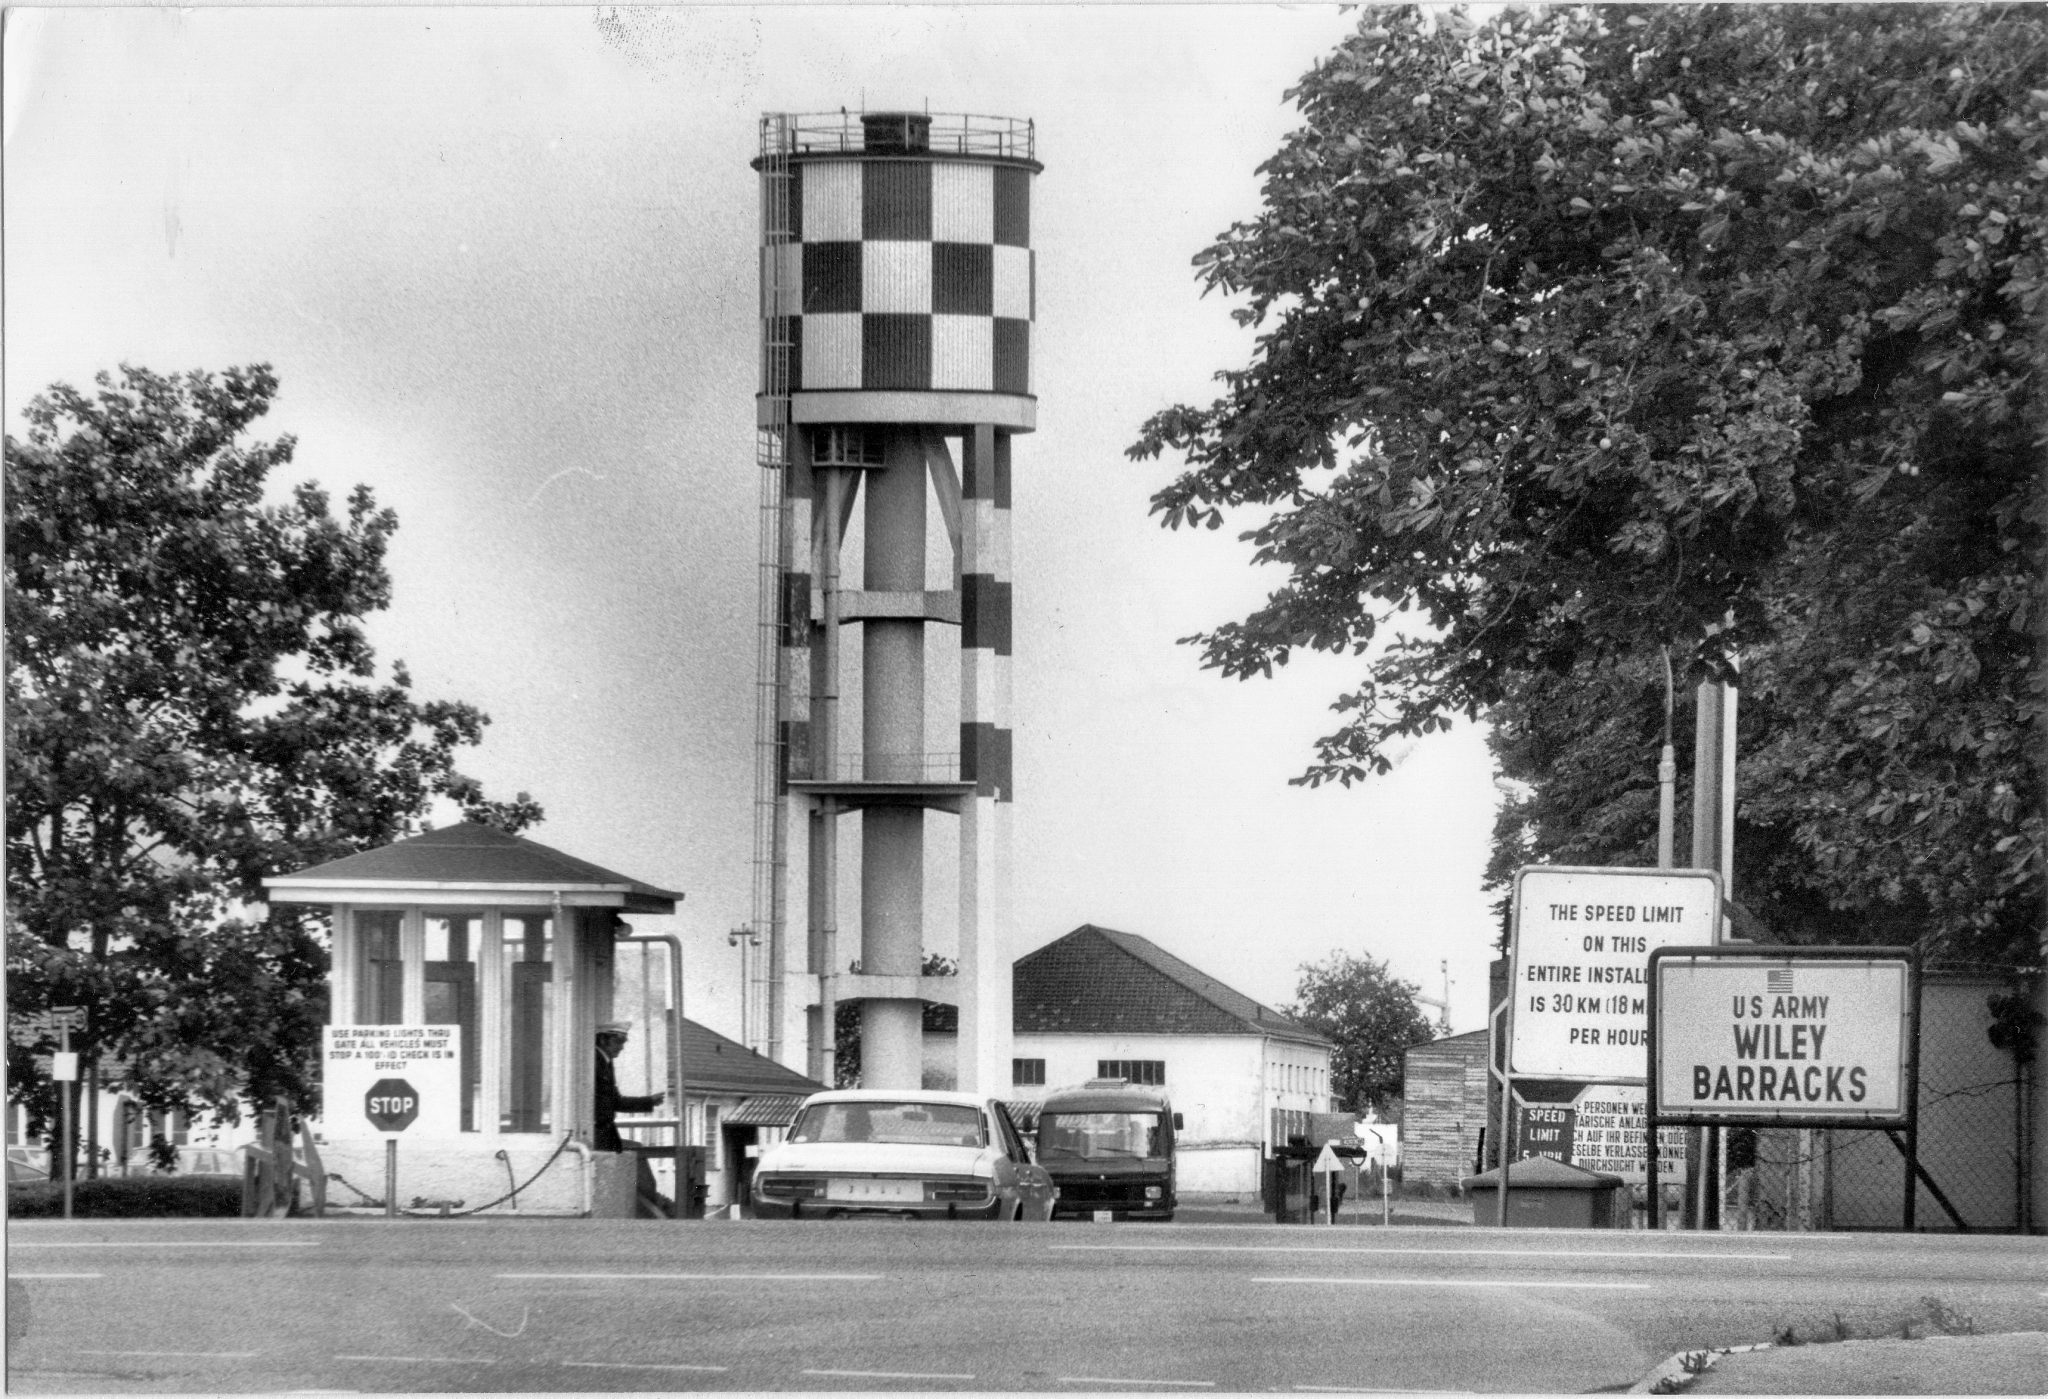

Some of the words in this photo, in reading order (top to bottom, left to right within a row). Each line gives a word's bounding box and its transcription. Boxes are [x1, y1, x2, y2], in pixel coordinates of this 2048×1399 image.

[1549, 904, 1578, 921] THE
[1585, 904, 1636, 922] SPEED
[1642, 906, 1684, 923] LIMIT
[1583, 935, 1604, 952] ON
[1611, 936, 1647, 953] THIS
[1527, 965, 1581, 982] ENTIRE
[1530, 996, 1545, 1013] IS
[1552, 993, 1573, 1013] 30
[1577, 996, 1600, 1014] KM
[1606, 994, 1628, 1015] (18
[1772, 995, 1829, 1019] ARMY
[352, 1029, 391, 1038] PARKING
[393, 1029, 424, 1038] LIGHTS
[428, 1029, 450, 1038] THRU
[1570, 1027, 1600, 1045] PER
[1607, 1029, 1648, 1047] HOUR
[334, 1039, 356, 1049] GATE
[360, 1039, 375, 1048] ALL
[379, 1039, 421, 1049] VEHICLES
[424, 1040, 448, 1048] MUST
[1732, 1024, 1827, 1060] WILEY
[329, 1050, 352, 1059] STOP
[400, 1050, 429, 1059] CHECK
[374, 1061, 407, 1070] EFFECT
[1693, 1065, 1868, 1102] BARRACKS
[370, 1097, 414, 1114] STOP
[1584, 1101, 1629, 1115] PERSONEN
[1529, 1109, 1566, 1123] SPEED
[1529, 1127, 1561, 1142] LIMIT
[1586, 1130, 1603, 1143] AUF
[1606, 1130, 1620, 1143] IHR
[1578, 1158, 1635, 1173] DURCHSUCHT
